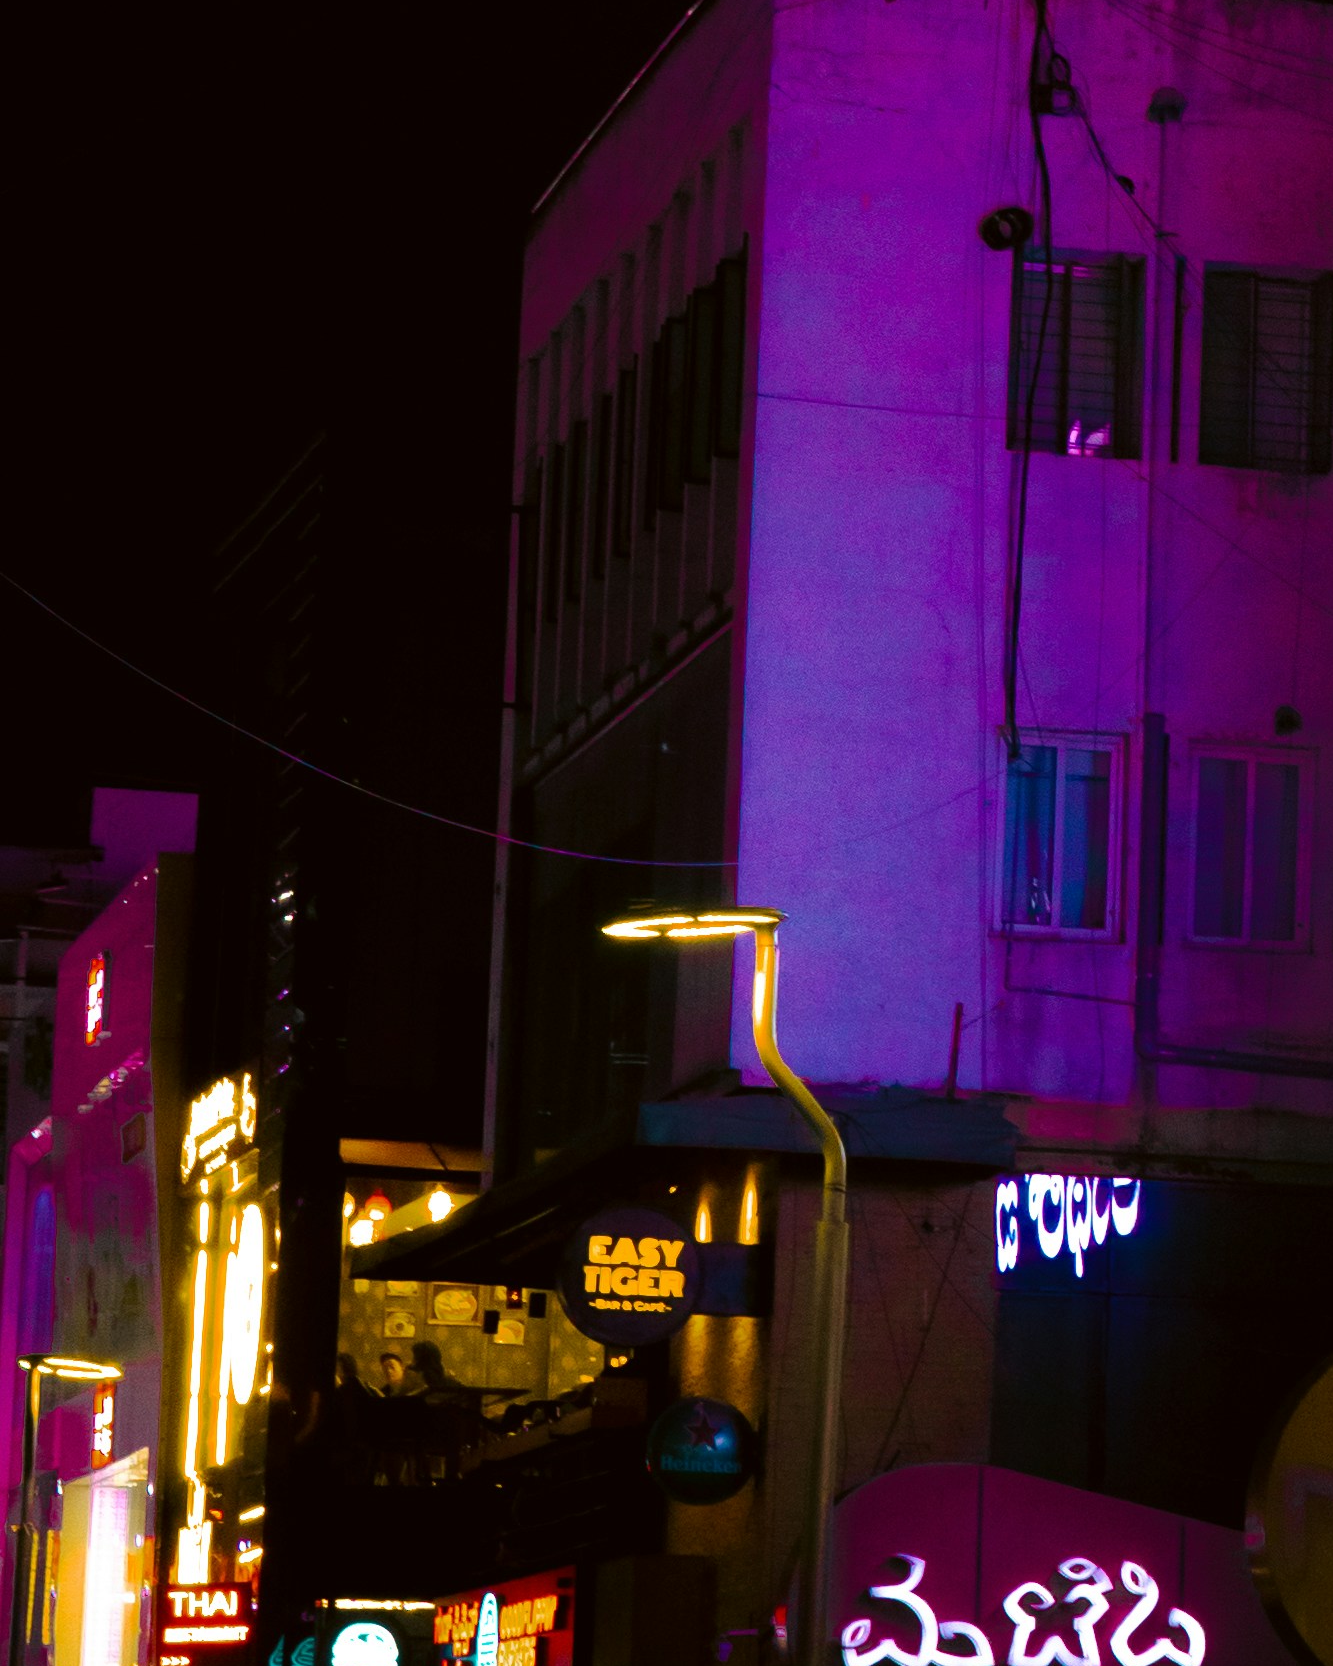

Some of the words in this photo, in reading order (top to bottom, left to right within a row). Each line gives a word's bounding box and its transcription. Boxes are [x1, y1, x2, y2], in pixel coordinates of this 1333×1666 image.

[588, 1235, 685, 1268] EASY
[583, 1265, 685, 1298] TIGER
[659, 1452, 743, 1475] Heineken
[168, 1590, 238, 1618] THAI
